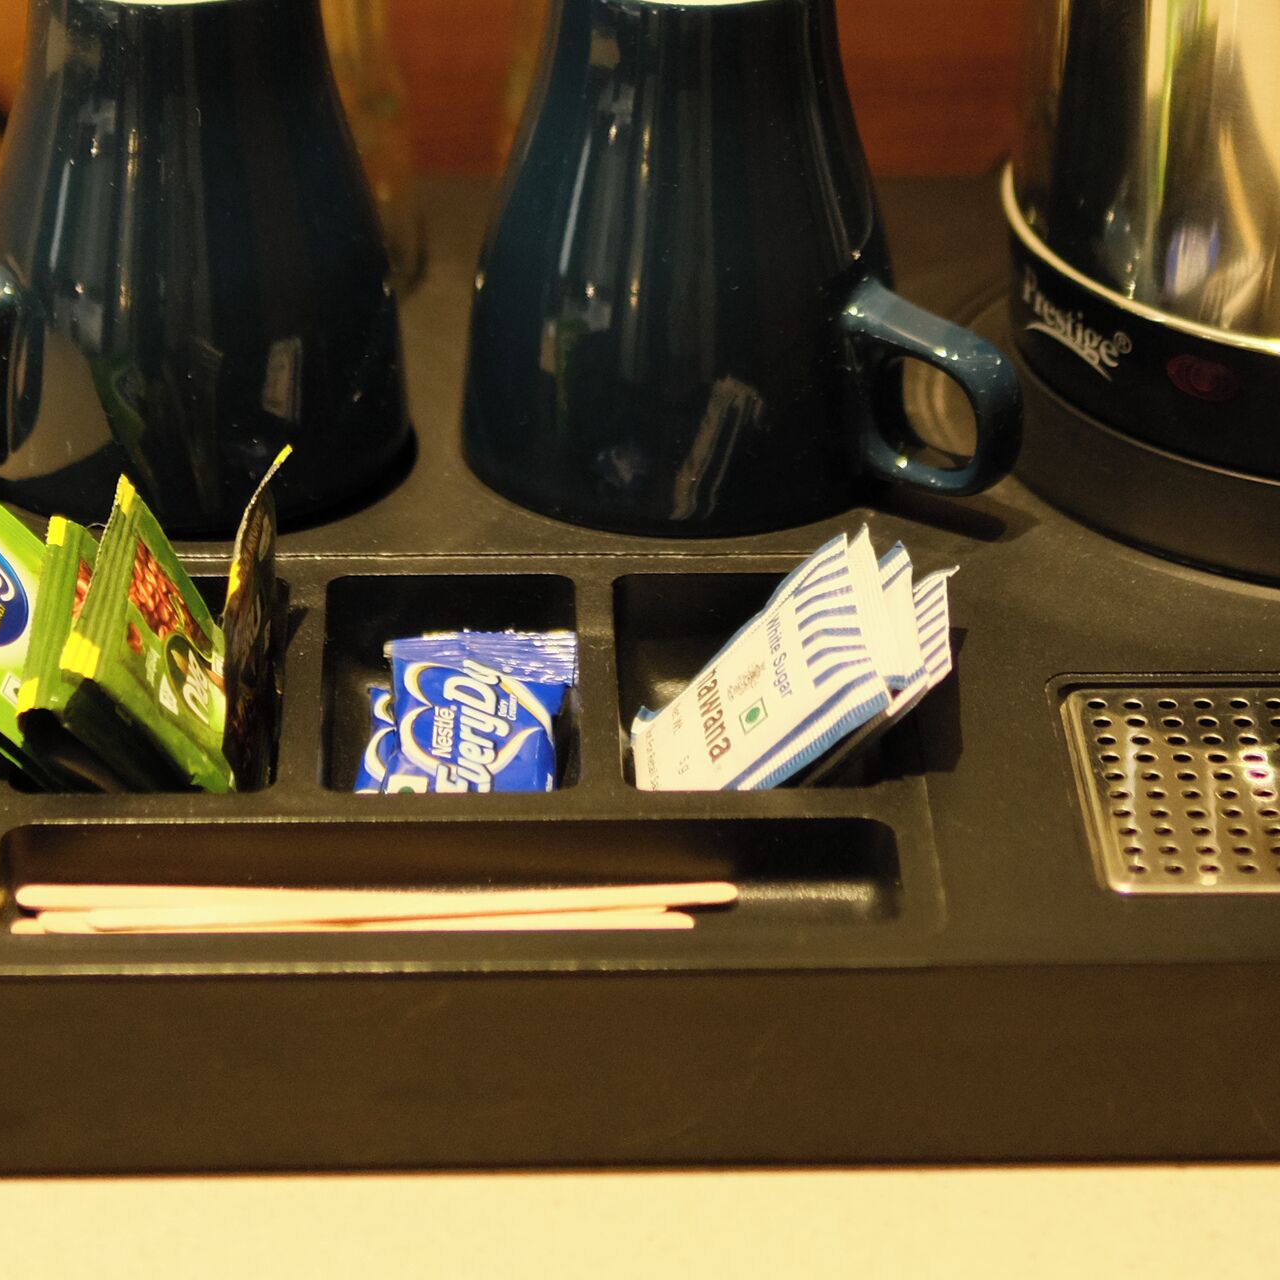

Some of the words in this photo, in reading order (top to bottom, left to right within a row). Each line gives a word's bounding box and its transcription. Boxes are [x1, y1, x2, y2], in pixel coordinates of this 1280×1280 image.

[1022, 267, 1120, 369] Prestige
[766, 613, 783, 655] White
[773, 651, 793, 699] Sugar
